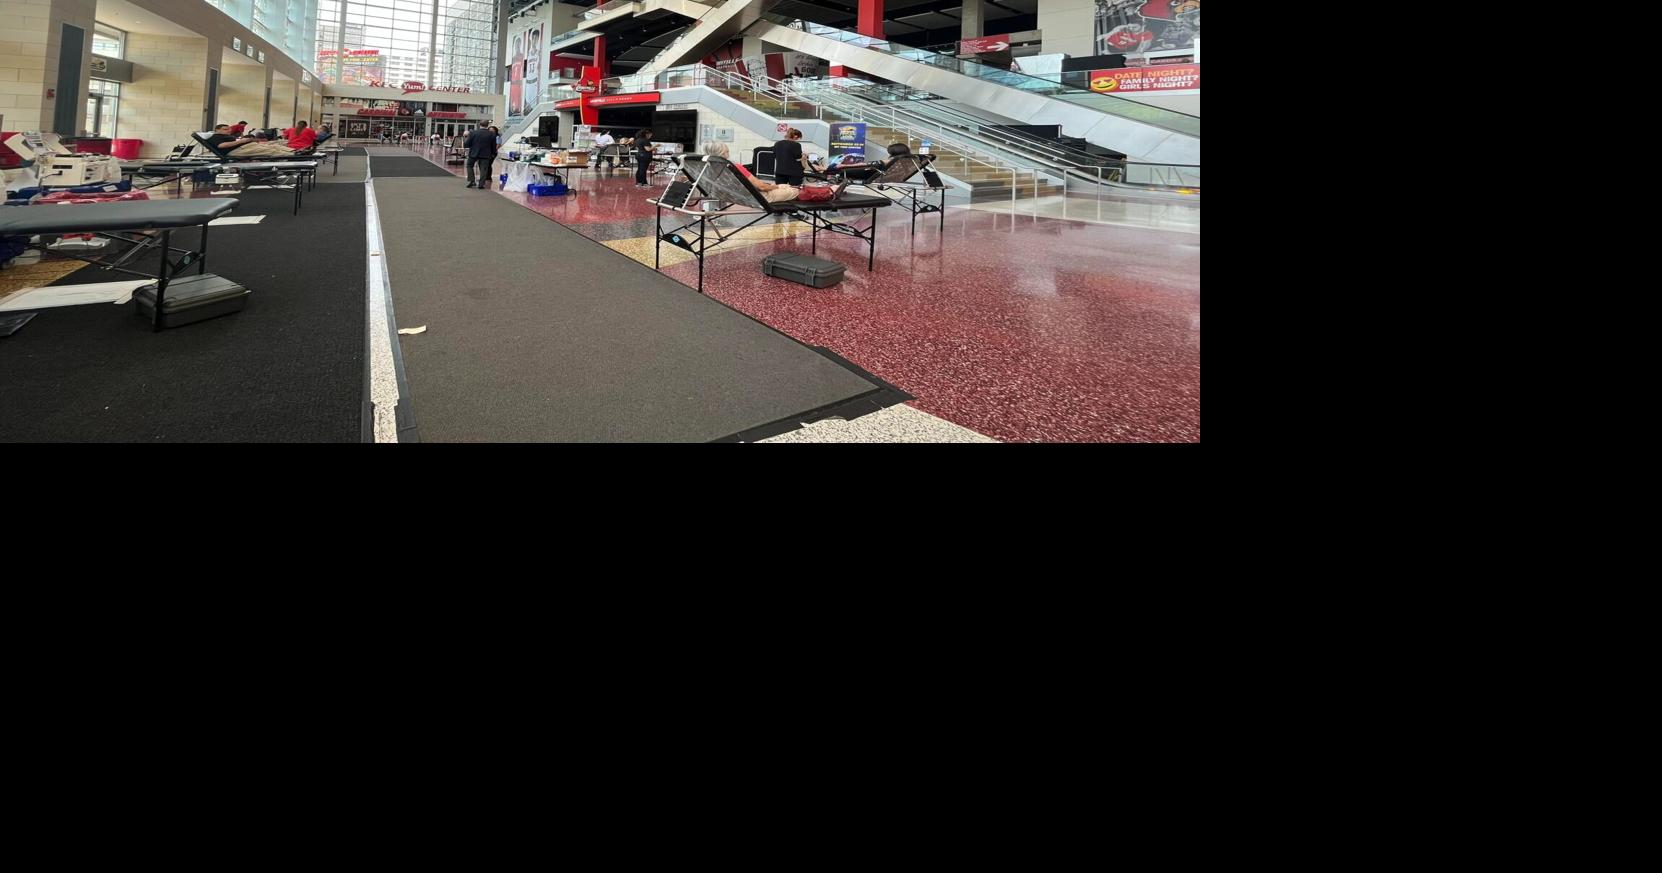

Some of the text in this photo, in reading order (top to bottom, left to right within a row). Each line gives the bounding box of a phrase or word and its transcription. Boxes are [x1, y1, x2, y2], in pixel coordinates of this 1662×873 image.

[1114, 68, 1194, 80] DATE NIGHT?
[1120, 74, 1199, 85] FAMILY NIGHT?
[403, 82, 425, 90] Yum!
[428, 85, 471, 93] CENTER
[1153, 81, 1193, 89] NIGHT?
